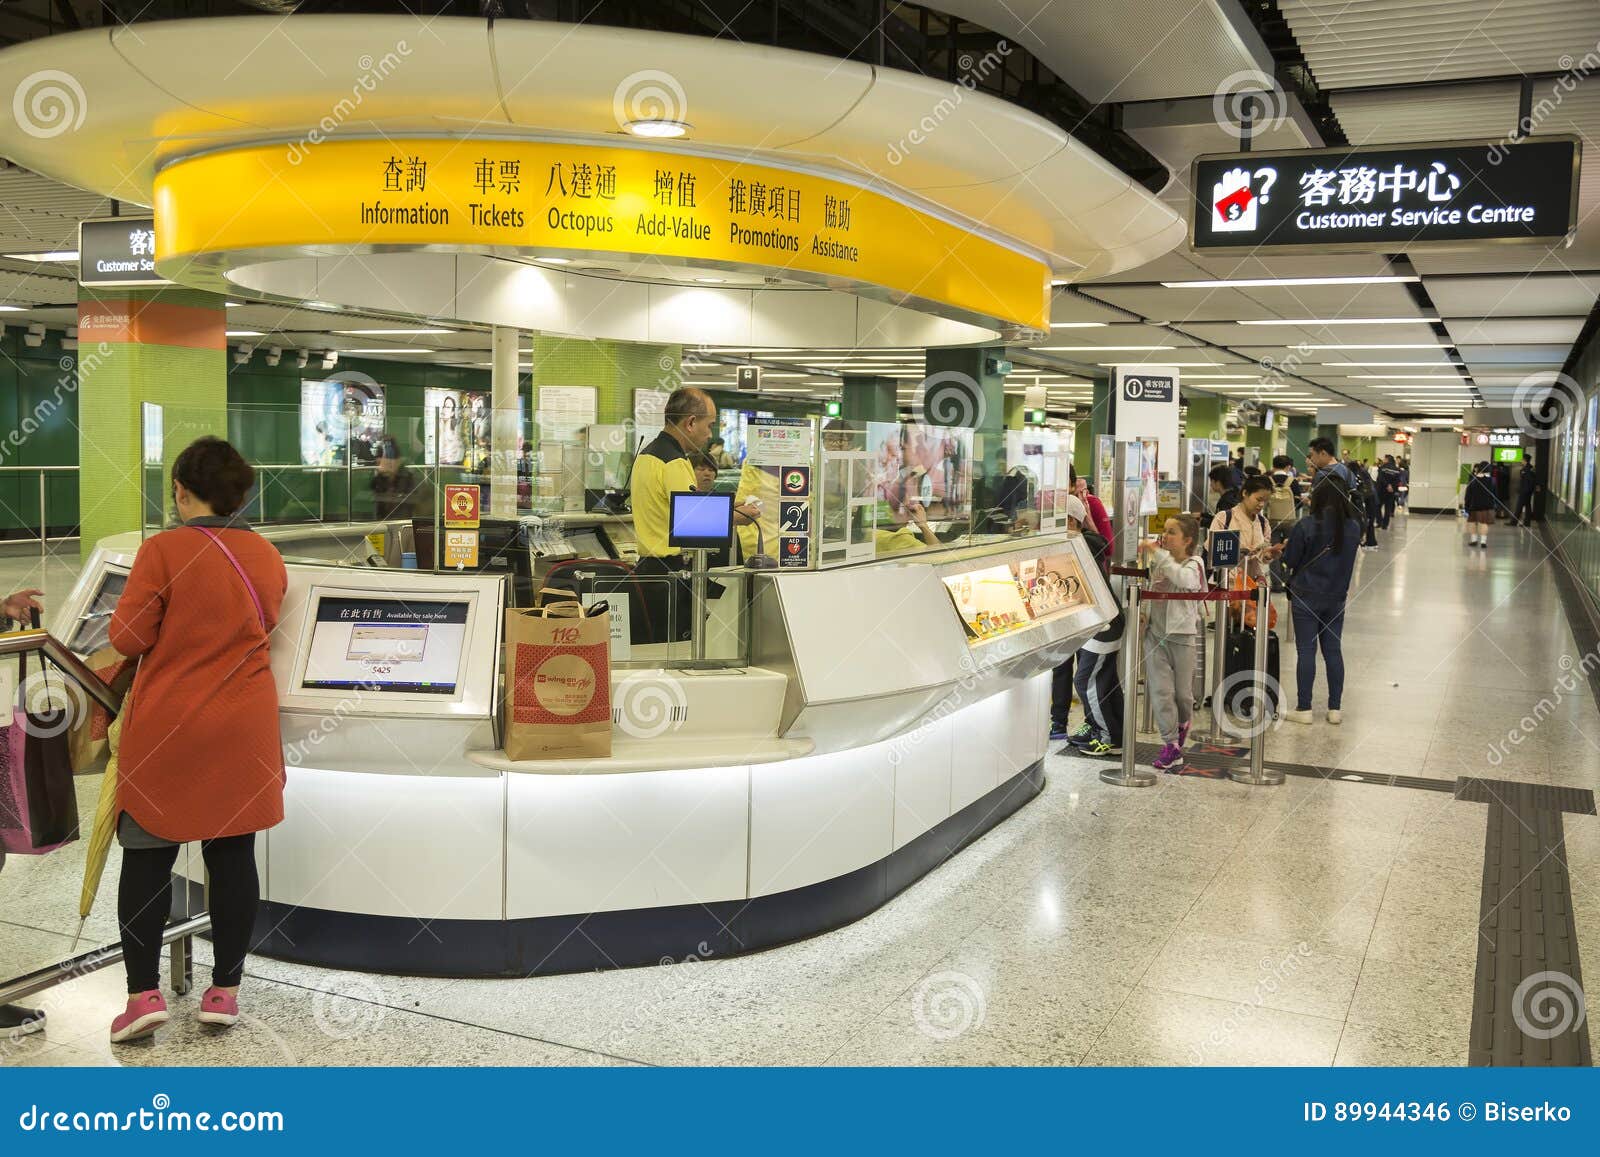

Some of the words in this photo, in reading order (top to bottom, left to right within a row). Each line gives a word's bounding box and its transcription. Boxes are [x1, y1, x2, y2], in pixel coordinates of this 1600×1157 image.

[1298, 161, 1461, 207] 客務中心
[382, 156, 427, 192] 查詢
[473, 158, 521, 195] 車票
[545, 162, 617, 200] 八達通
[653, 169, 697, 209] 增值
[728, 178, 801, 224] 推廣項目
[824, 194, 851, 232] 協助
[1296, 207, 1386, 230] Customer
[1390, 206, 1461, 228] Service
[1466, 205, 1535, 226] Centre
[360, 202, 449, 225] Information
[468, 203, 524, 228] Tickets
[547, 207, 614, 237] Octopus
[636, 213, 711, 241] Add-Value
[730, 222, 799, 252] Promotions
[811, 235, 858, 262] Assistance
[97, 260, 138, 273] Customer
[1216, 539, 1233, 552] 出口
[340, 608, 383, 619] 在此有售
[413, 612, 422, 620] for
